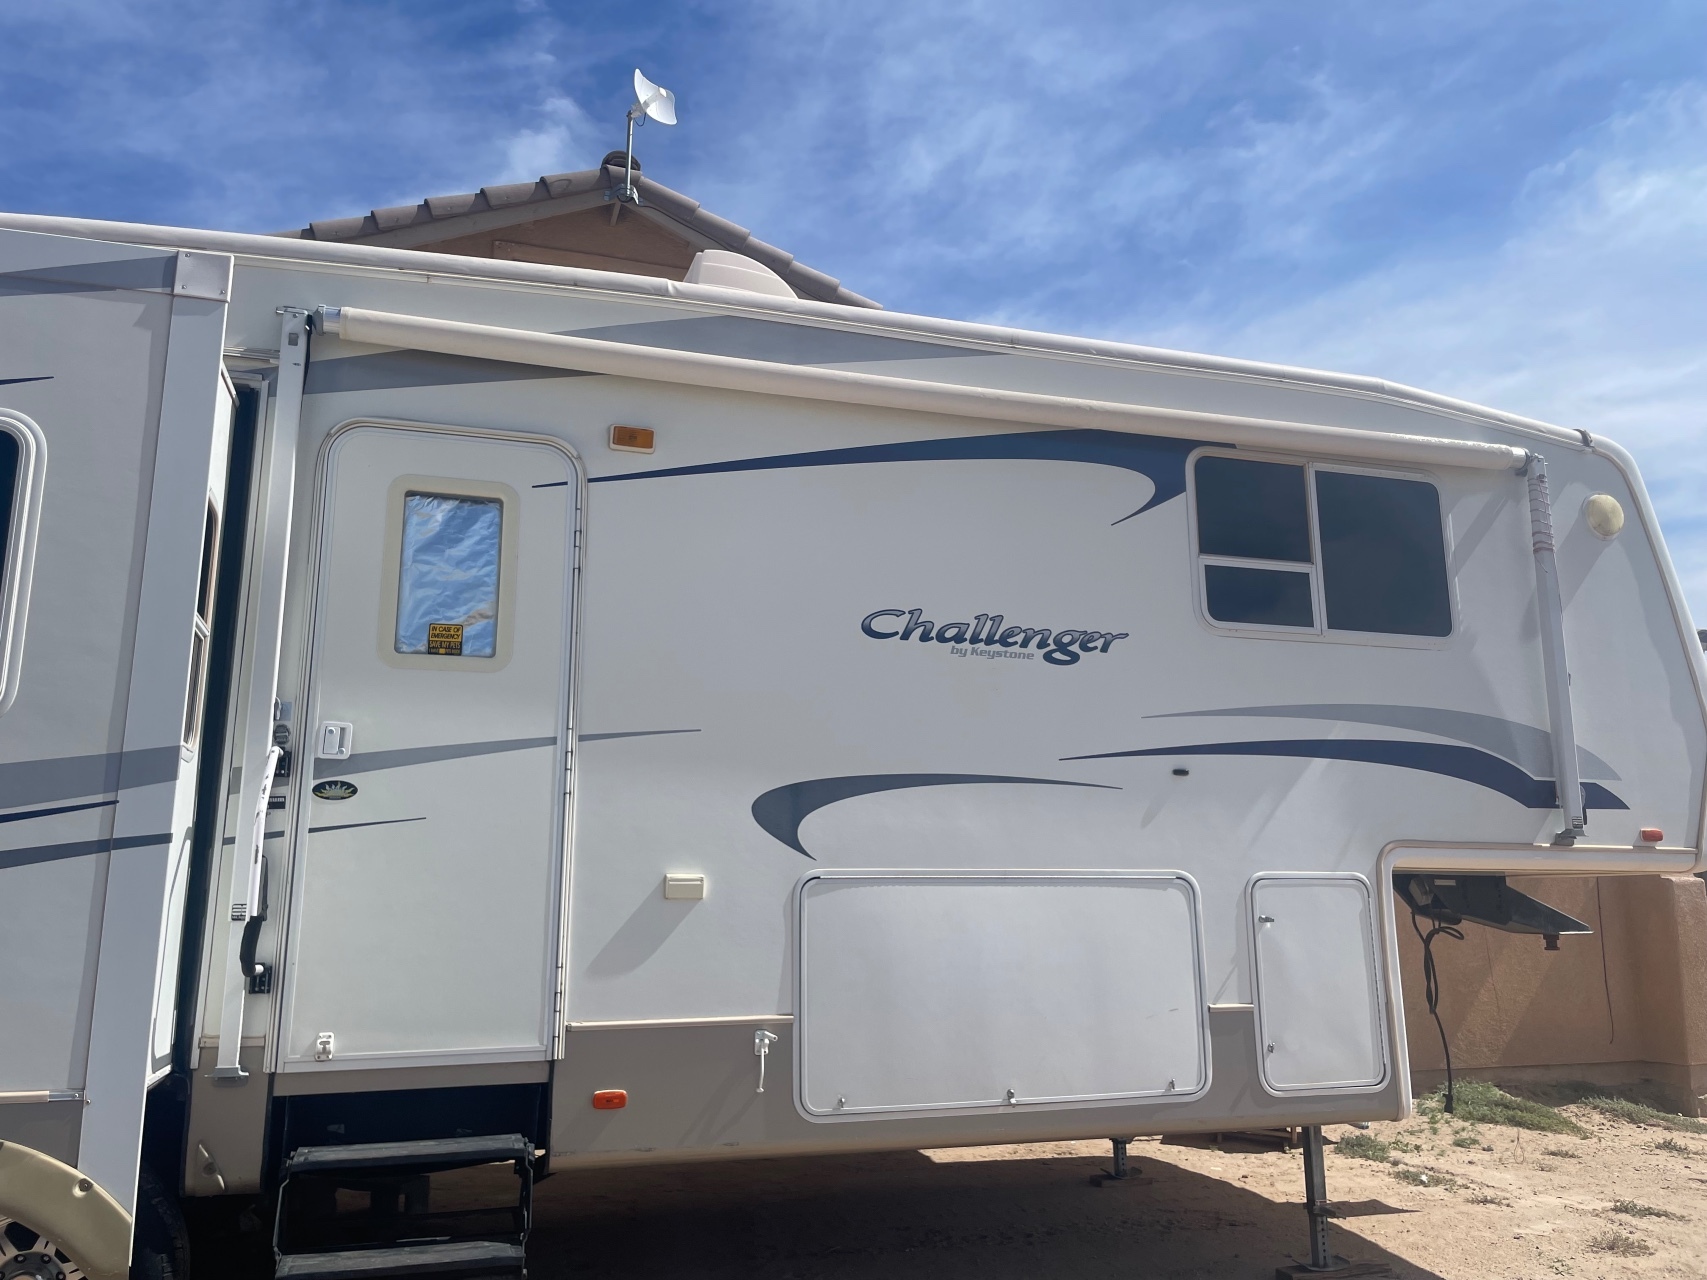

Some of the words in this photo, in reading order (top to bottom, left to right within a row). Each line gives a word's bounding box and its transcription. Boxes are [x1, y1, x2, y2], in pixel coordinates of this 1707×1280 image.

[861, 608, 1129, 666] Challenger
[950, 645, 968, 658] by
[970, 646, 1035, 660] Keystone
